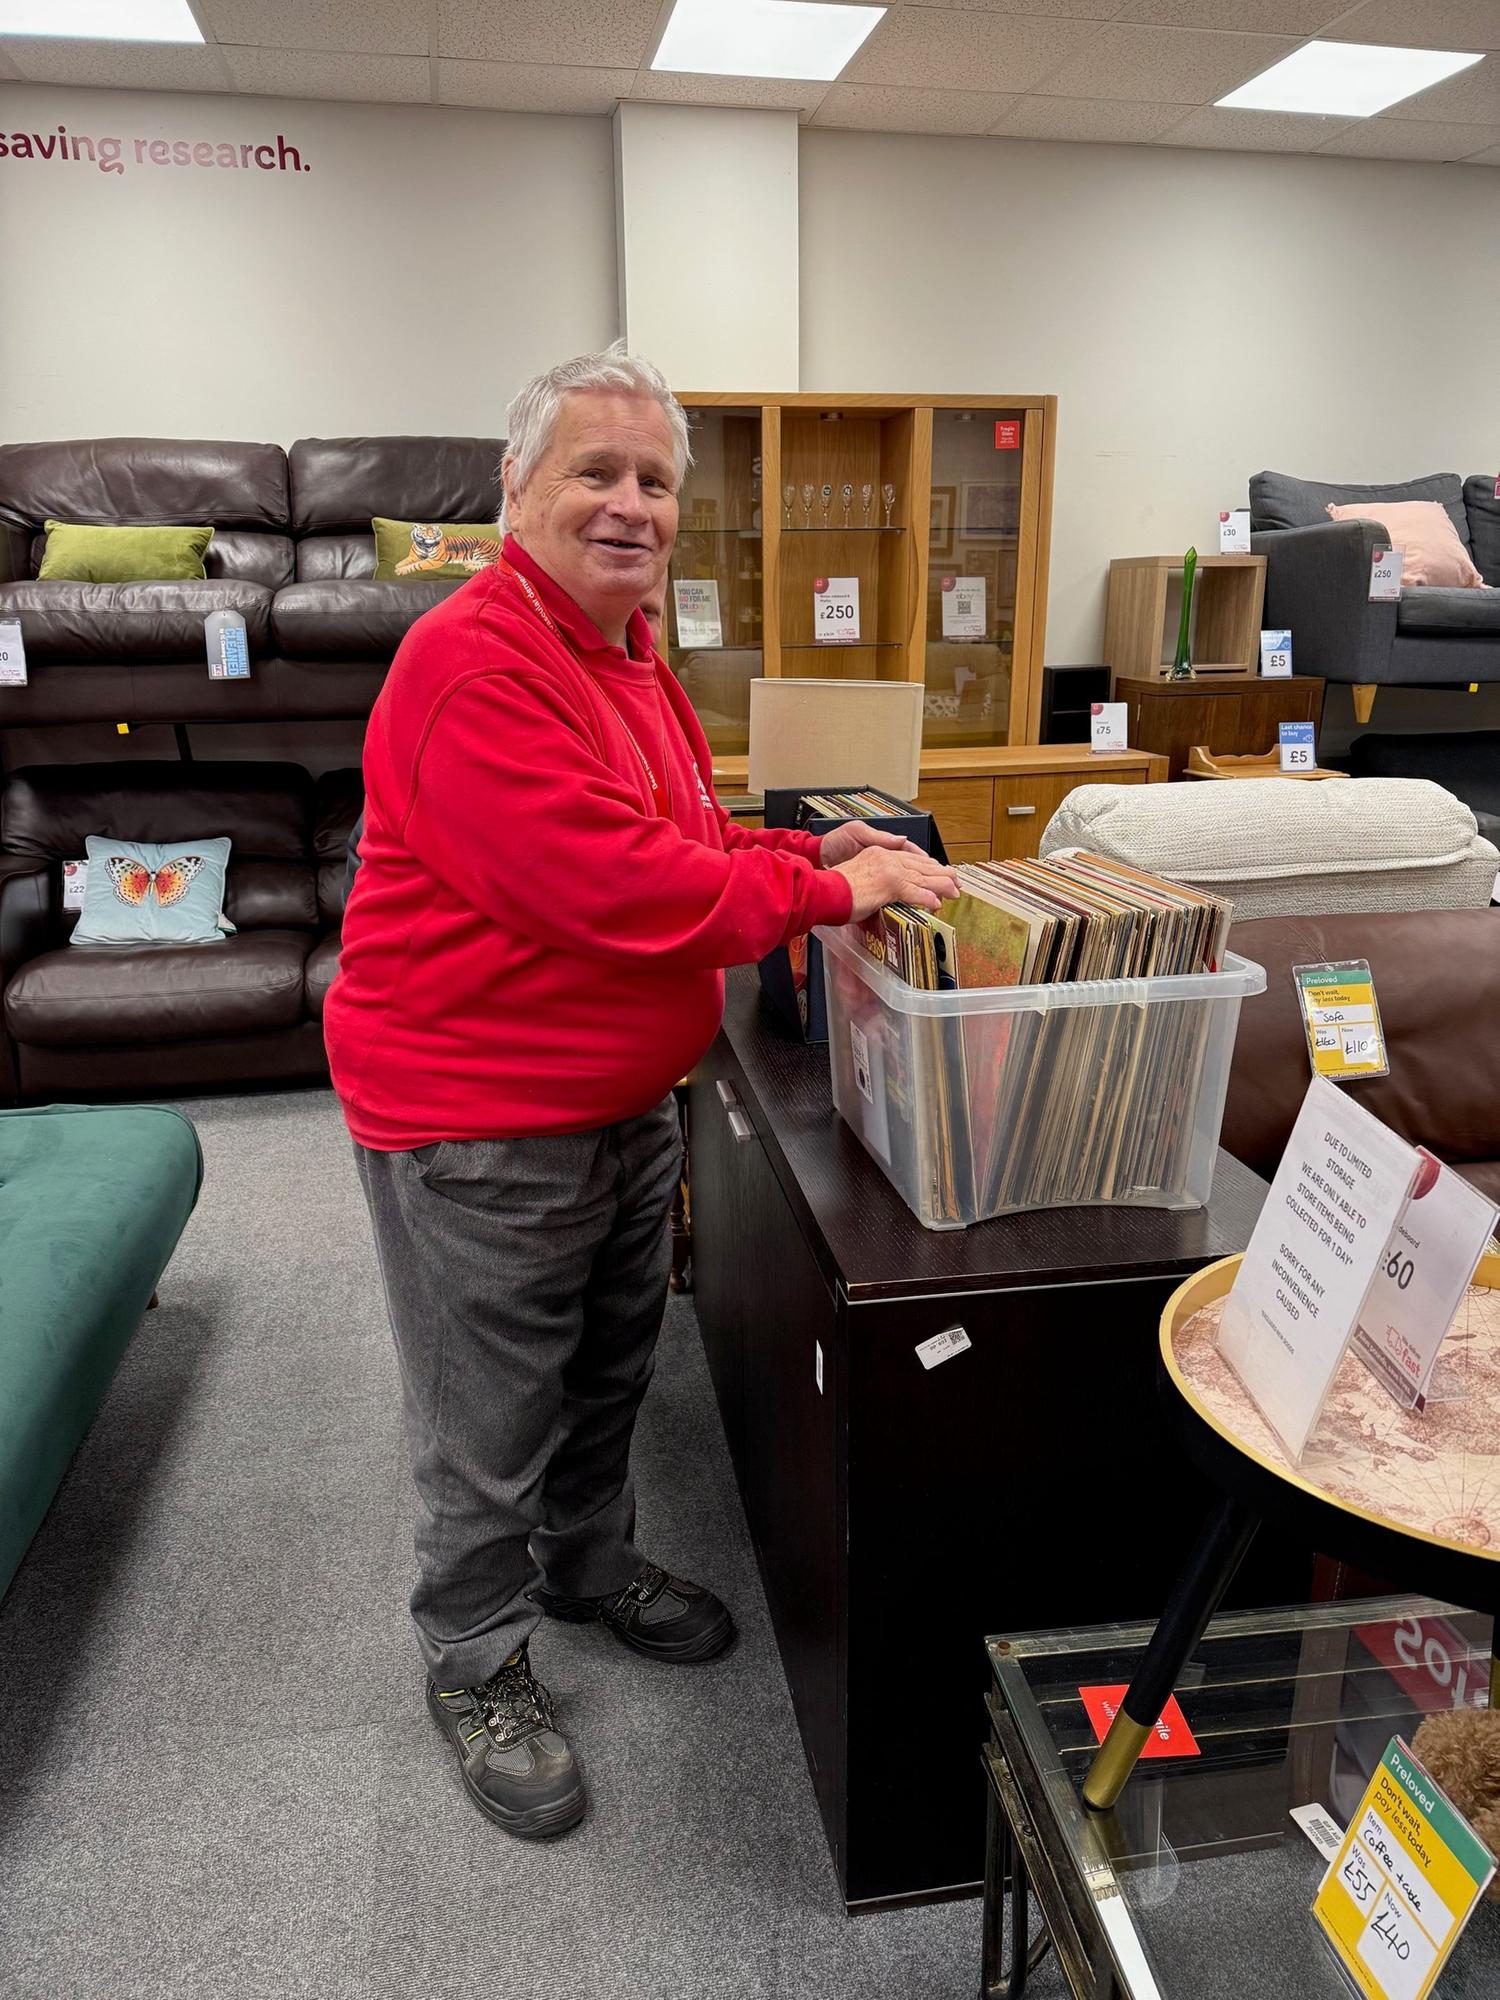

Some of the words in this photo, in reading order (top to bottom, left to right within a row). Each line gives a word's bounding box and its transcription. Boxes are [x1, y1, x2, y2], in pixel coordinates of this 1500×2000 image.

[134, 135, 311, 172] research.
[1374, 570, 1391, 578] £250
[820, 605, 854, 619] £250
[225, 628, 239, 676] CLEANED
[1270, 655, 1286, 667] £5
[1096, 726, 1112, 734] £75
[1290, 750, 1308, 763] £5
[1306, 976, 1338, 985] Preloved
[1308, 989, 1325, 997] Don't
[1323, 1011, 1344, 1023] Sofa
[1345, 1040, 1369, 1055] £110
[1324, 1131, 1340, 1150] DUE
[1338, 1143, 1349, 1158] TO
[1346, 1150, 1373, 1179] LIMITED
[1326, 1157, 1356, 1190] STORAGE
[1301, 1160, 1313, 1178] WE
[1310, 1171, 1325, 1189] ARE
[1323, 1182, 1342, 1205] ONLY
[1338, 1199, 1358, 1220] ABLE
[1355, 1212, 1367, 1229] TO
[1285, 1194, 1320, 1233] COLLECTED
[1317, 1227, 1332, 1247] FOR
[1330, 1242, 1337, 1252] 1
[1297, 1182, 1319, 1207] STORE
[1315, 1200, 1336, 1225] ITEMS
[1333, 1218, 1356, 1244] BEING
[1398, 1225, 1421, 1249] deboard
[1280, 1243, 1301, 1270] SORRY
[1298, 1264, 1312, 1285] FOR
[1310, 1279, 1326, 1298] ANY
[1381, 1249, 1415, 1290] 60
[1272, 1259, 1320, 1319] INCONVENIENCE
[1275, 1289, 1300, 1321] CAUSED
[1402, 1347, 1420, 1378] fast
[1102, 1701, 1117, 1720] with
[1390, 1753, 1435, 1814] Preloved
[1380, 1777, 1403, 1809] Don't
[1401, 1807, 1421, 1837] wait,
[1367, 1811, 1383, 1836] Item
[1374, 1791, 1392, 1814] pay
[1391, 1811, 1407, 1834] less
[1407, 1831, 1432, 1869] today
[1351, 1844, 1366, 1869] Was
[1363, 1829, 1394, 1872] Coffee
[1343, 1860, 1377, 1901] £55
[1384, 1891, 1402, 1918] Now
